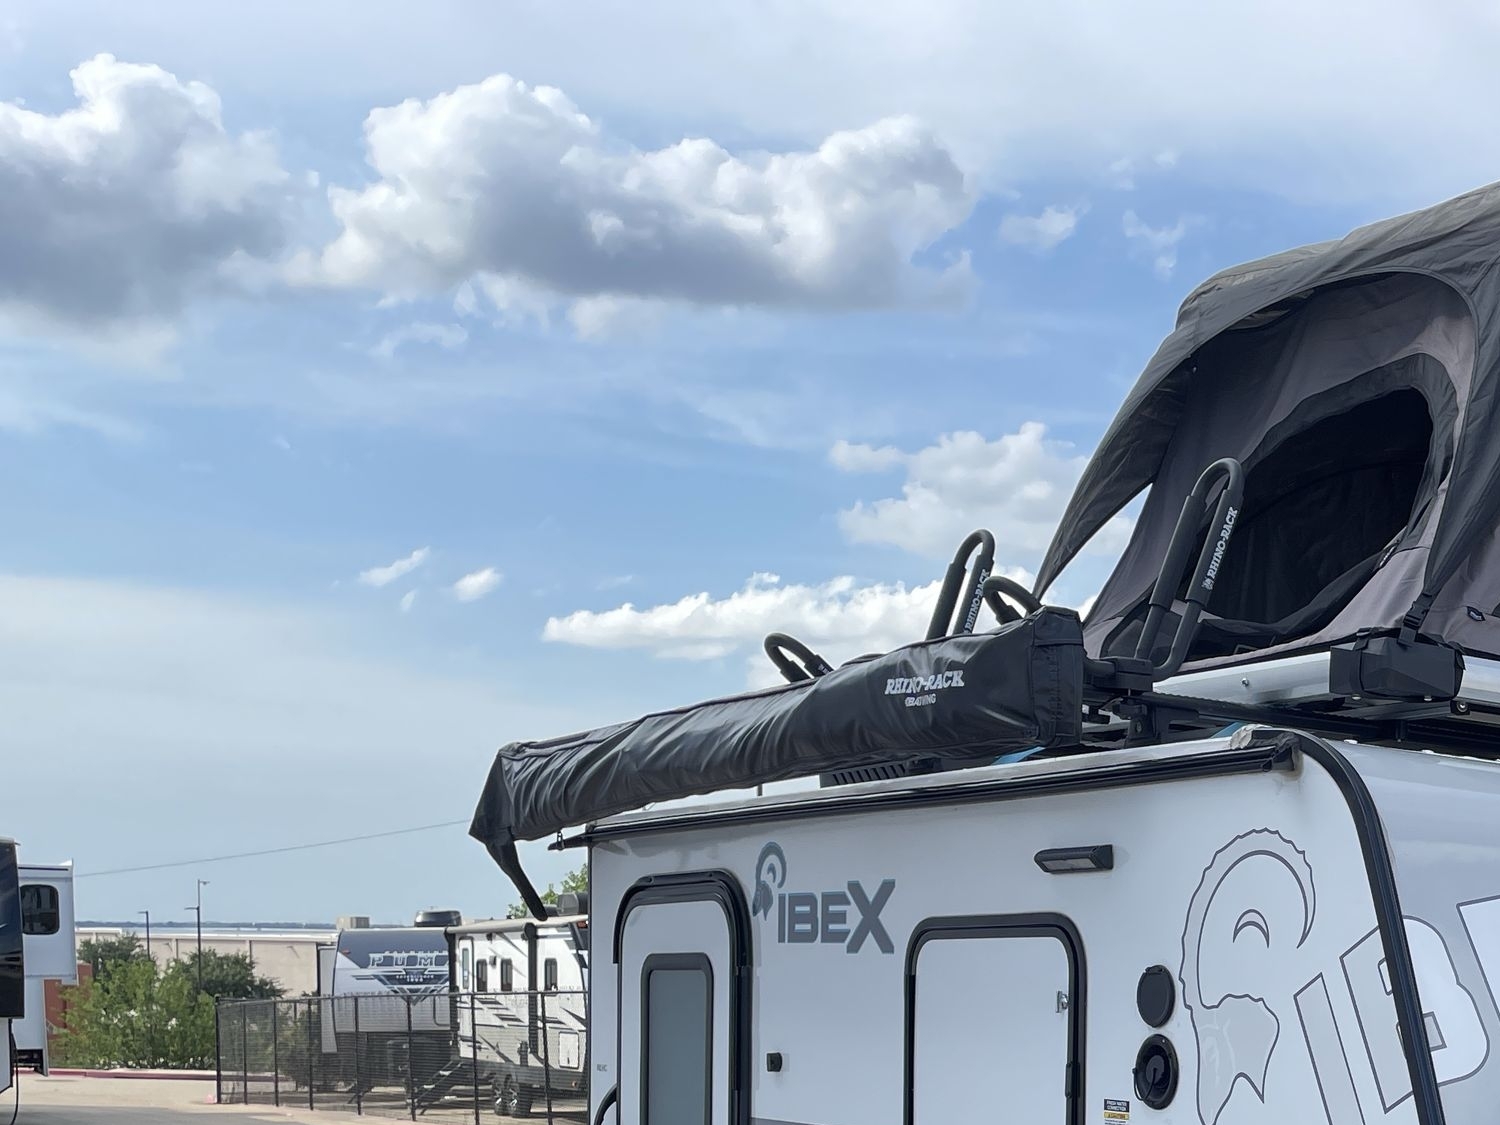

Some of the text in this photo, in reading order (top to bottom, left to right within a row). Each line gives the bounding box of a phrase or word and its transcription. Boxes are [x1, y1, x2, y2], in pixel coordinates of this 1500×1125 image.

[1207, 506, 1238, 579] RHINO-RACK
[884, 669, 965, 695] RHINO-RACK
[777, 878, 896, 954] IBEX
[368, 953, 449, 969] PUM
